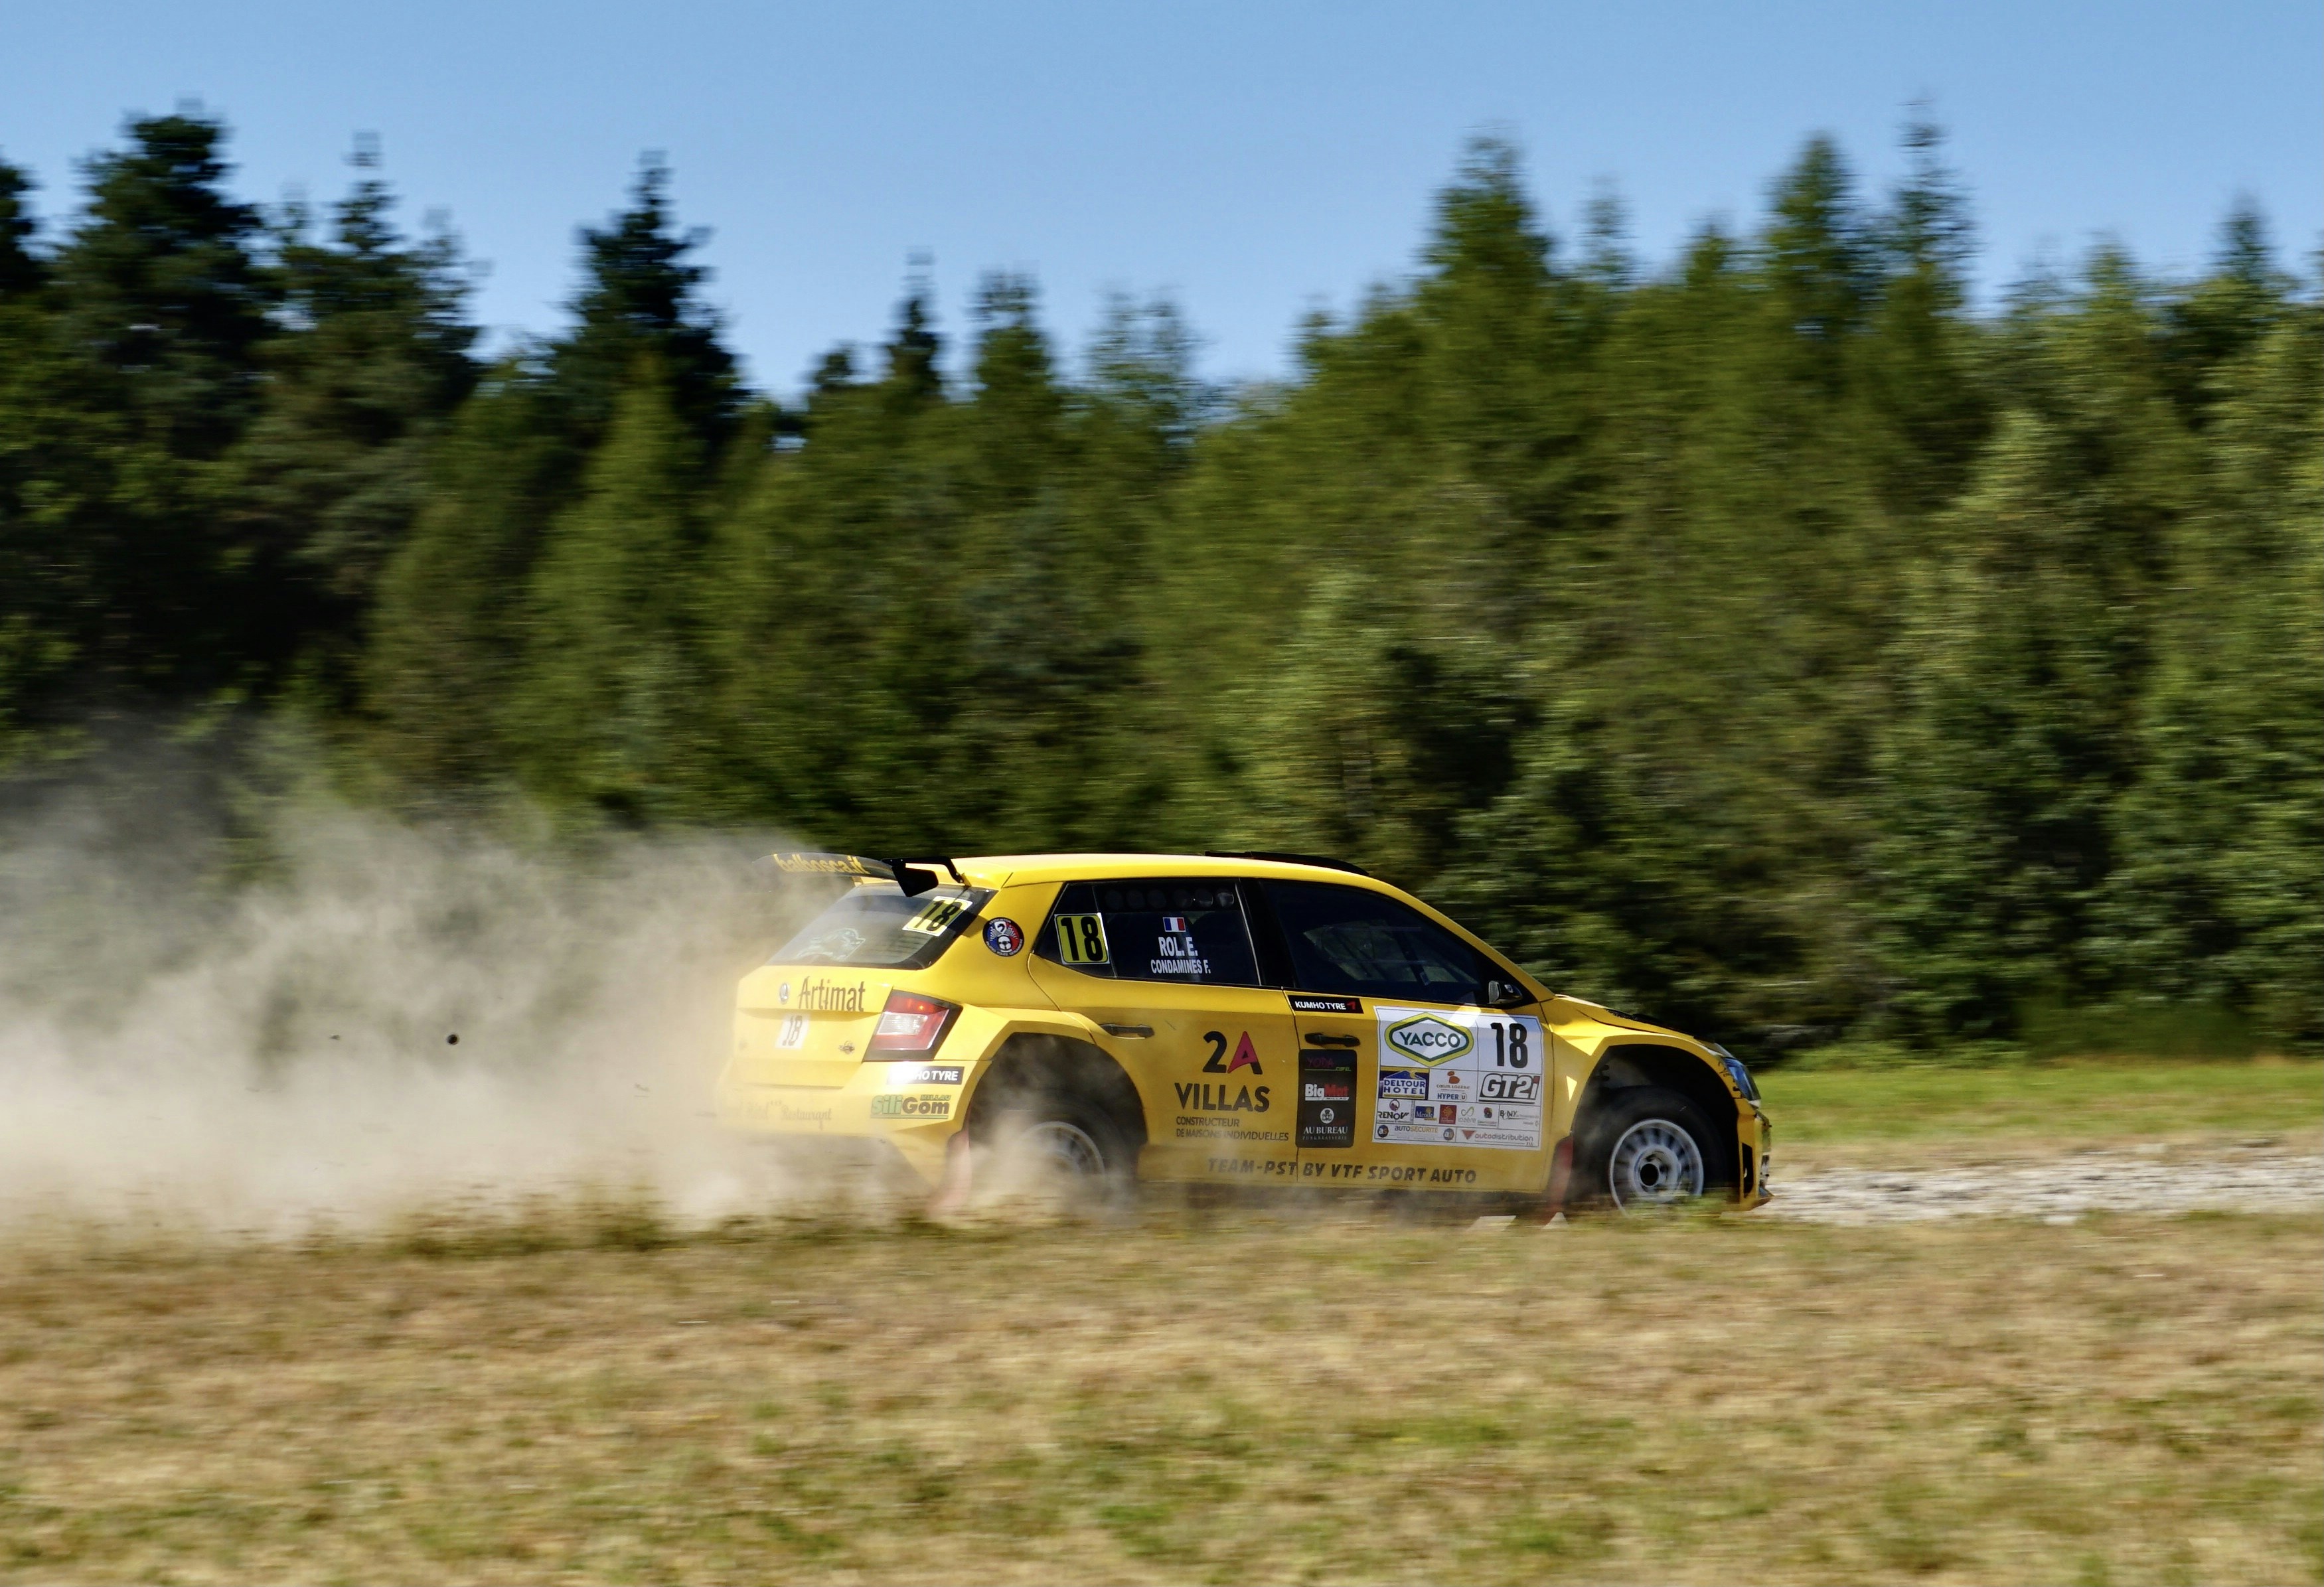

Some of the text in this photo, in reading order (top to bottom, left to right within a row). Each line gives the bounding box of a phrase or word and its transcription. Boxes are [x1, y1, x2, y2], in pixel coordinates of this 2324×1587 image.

[915, 899, 963, 932] 18
[1060, 916, 1103, 962] 18
[1186, 937, 1198, 956] E.
[1150, 959, 1211, 974] CONDAMINES F.
[798, 976, 866, 1012] Artimat
[1399, 1031, 1460, 1048] YACCO
[1490, 1022, 1528, 1069] 18
[1202, 1031, 1263, 1075] 2A
[931, 1070, 959, 1081] TYRE
[1384, 1079, 1426, 1088] DELTOUR
[870, 1095, 950, 1114] SiliGom
[1174, 1083, 1271, 1113] VILLAS
[1176, 1116, 1240, 1127] CONSTRUCTEUR
[1176, 1128, 1184, 1138] DE
[1224, 1131, 1289, 1141] INDIVIDUELLES
[1474, 1132, 1533, 1142] autodistribution
[1207, 1158, 1477, 1184] TEAM-PST BY VTF SPORT AUTO
